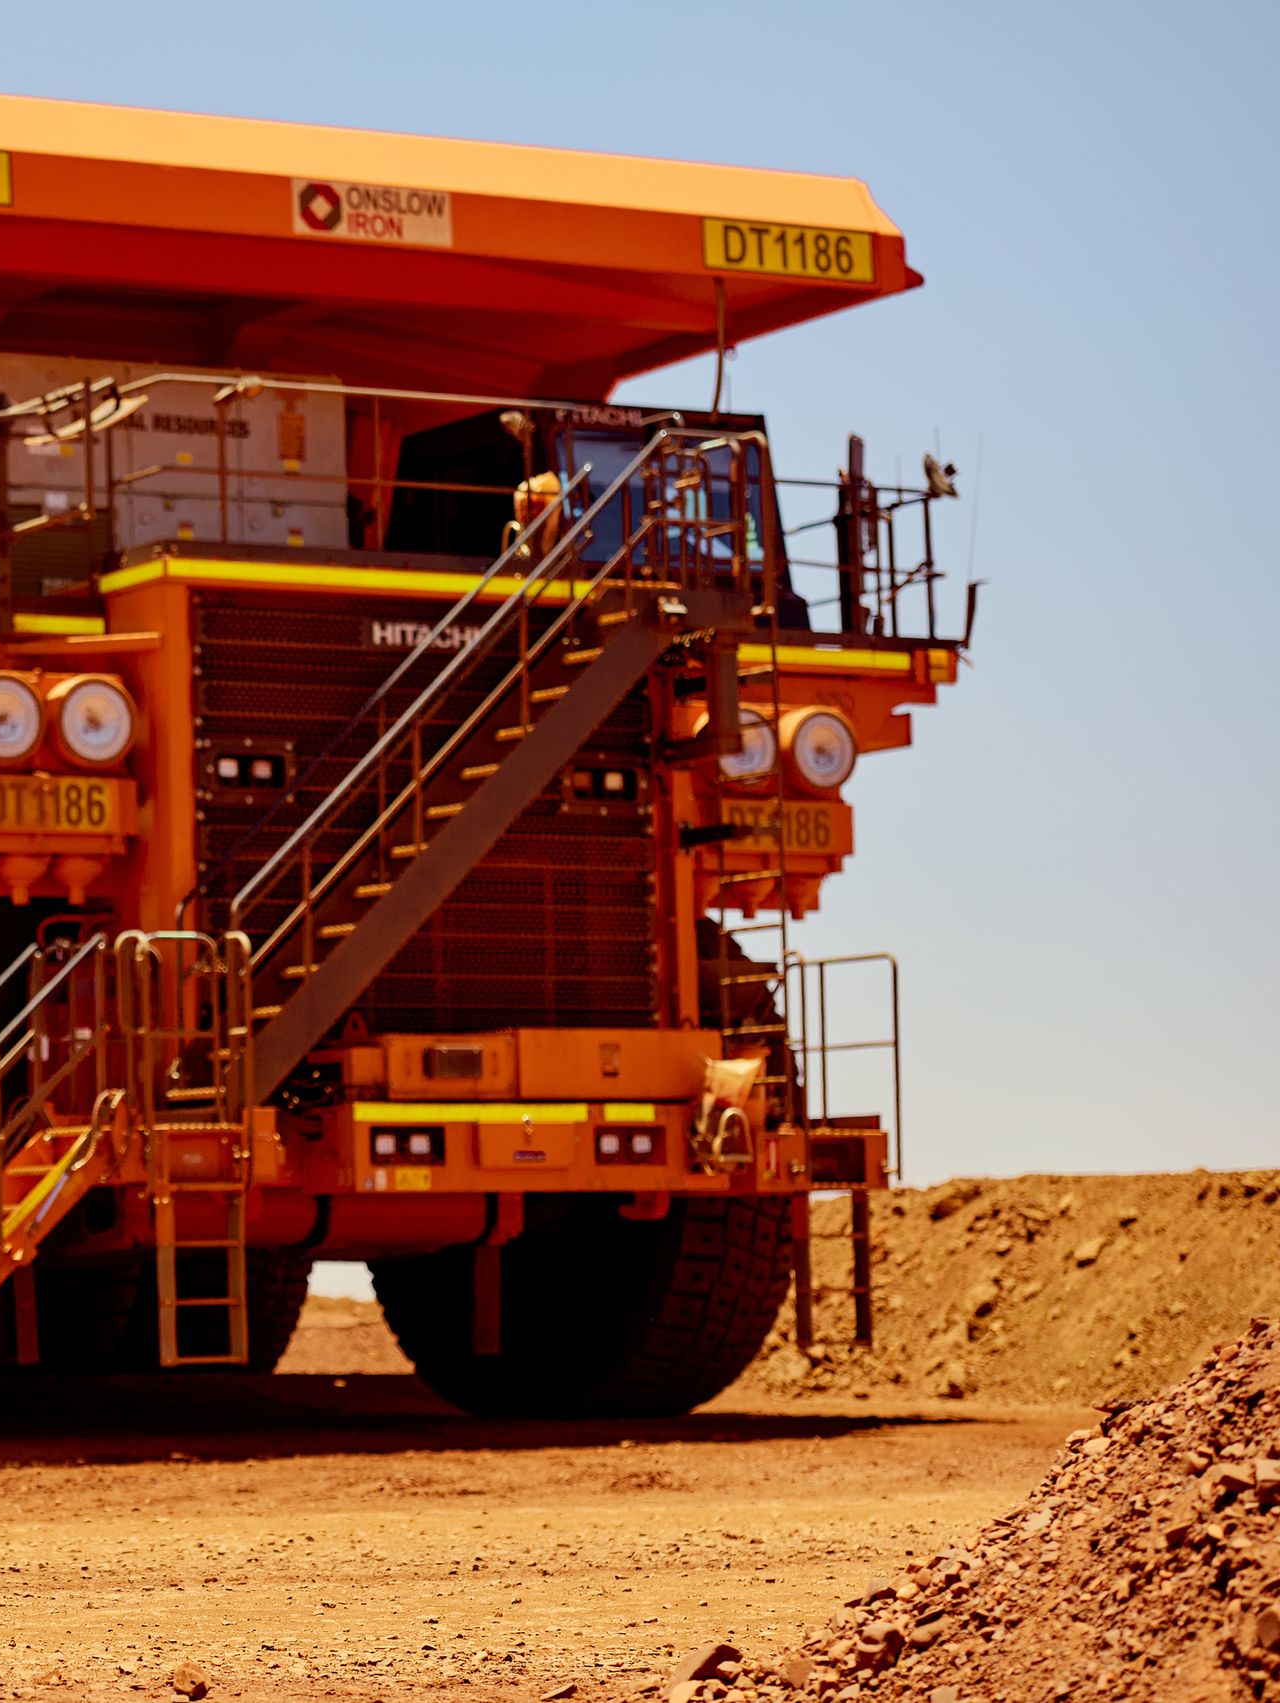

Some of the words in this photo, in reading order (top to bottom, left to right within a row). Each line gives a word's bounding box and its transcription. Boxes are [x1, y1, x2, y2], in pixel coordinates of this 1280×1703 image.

[346, 187, 446, 216] ONSLOW
[347, 213, 404, 238] IRON
[723, 224, 853, 274] DT1186
[151, 413, 250, 438] RESOURES
[729, 806, 831, 848] DT186
